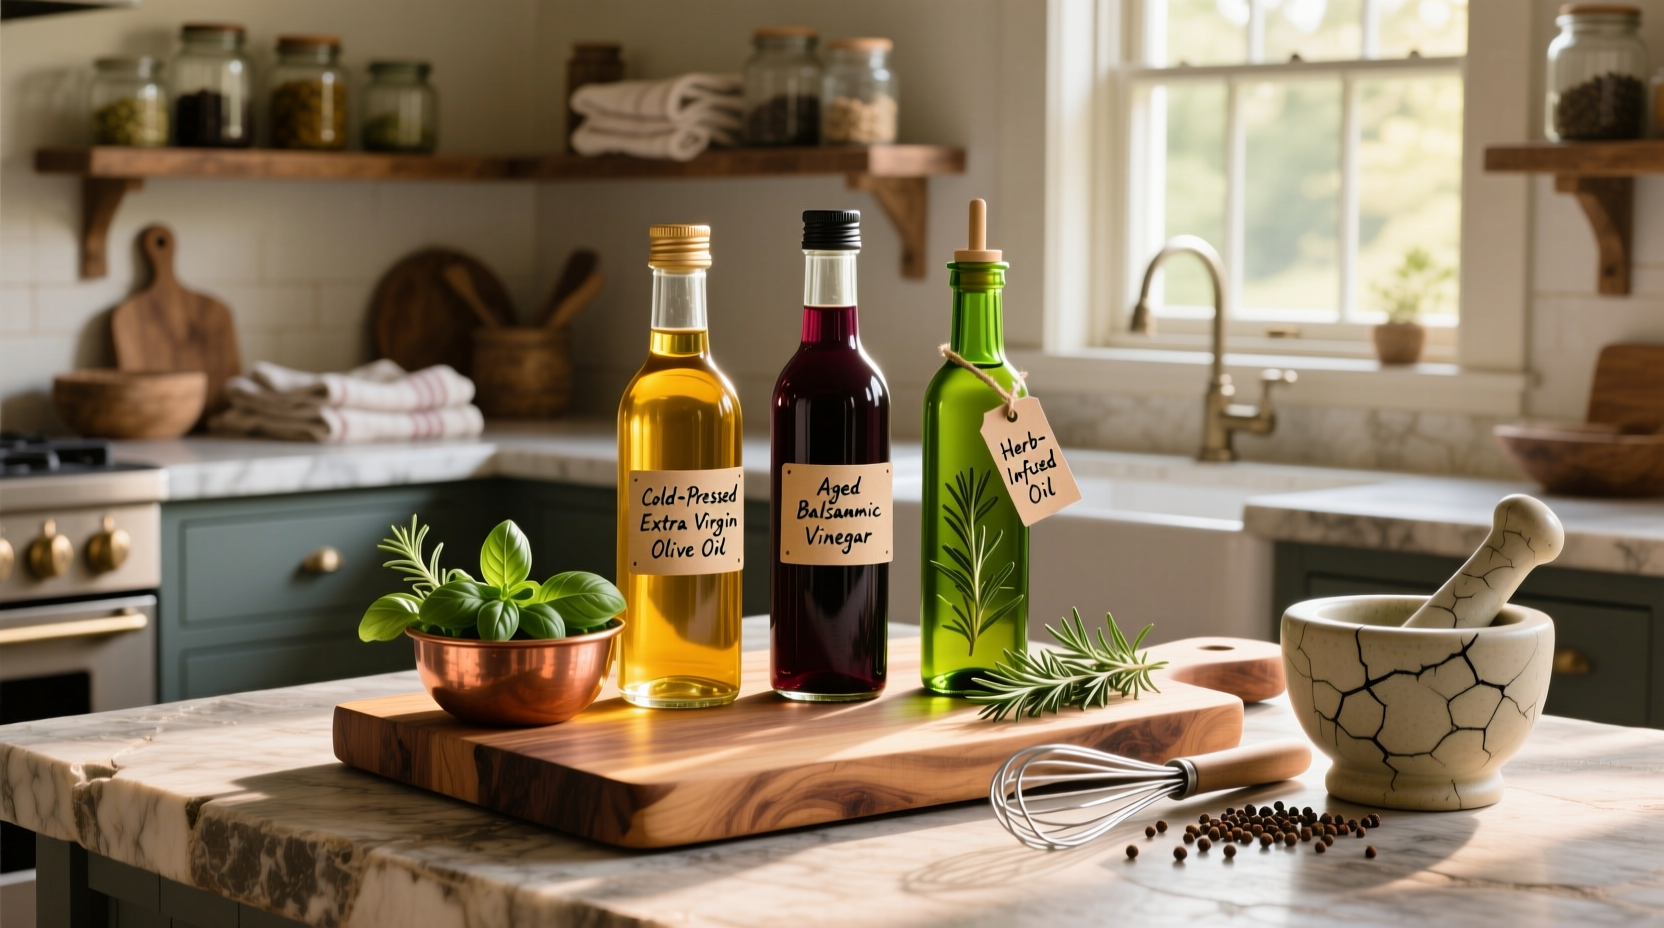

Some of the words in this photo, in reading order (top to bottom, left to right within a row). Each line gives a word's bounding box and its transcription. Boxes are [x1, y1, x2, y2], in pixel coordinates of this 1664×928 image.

[1000, 431, 1046, 461] Herb-
[1007, 448, 1057, 485] Infused
[642, 483, 738, 507] Cold-Pressed
[817, 476, 861, 504] Aged
[1029, 476, 1056, 504] Oil
[640, 513, 687, 532] Extra
[695, 512, 737, 537] Virgin
[651, 538, 695, 559] Olive
[702, 537, 726, 557] Oil
[806, 525, 872, 554] Vinegar
